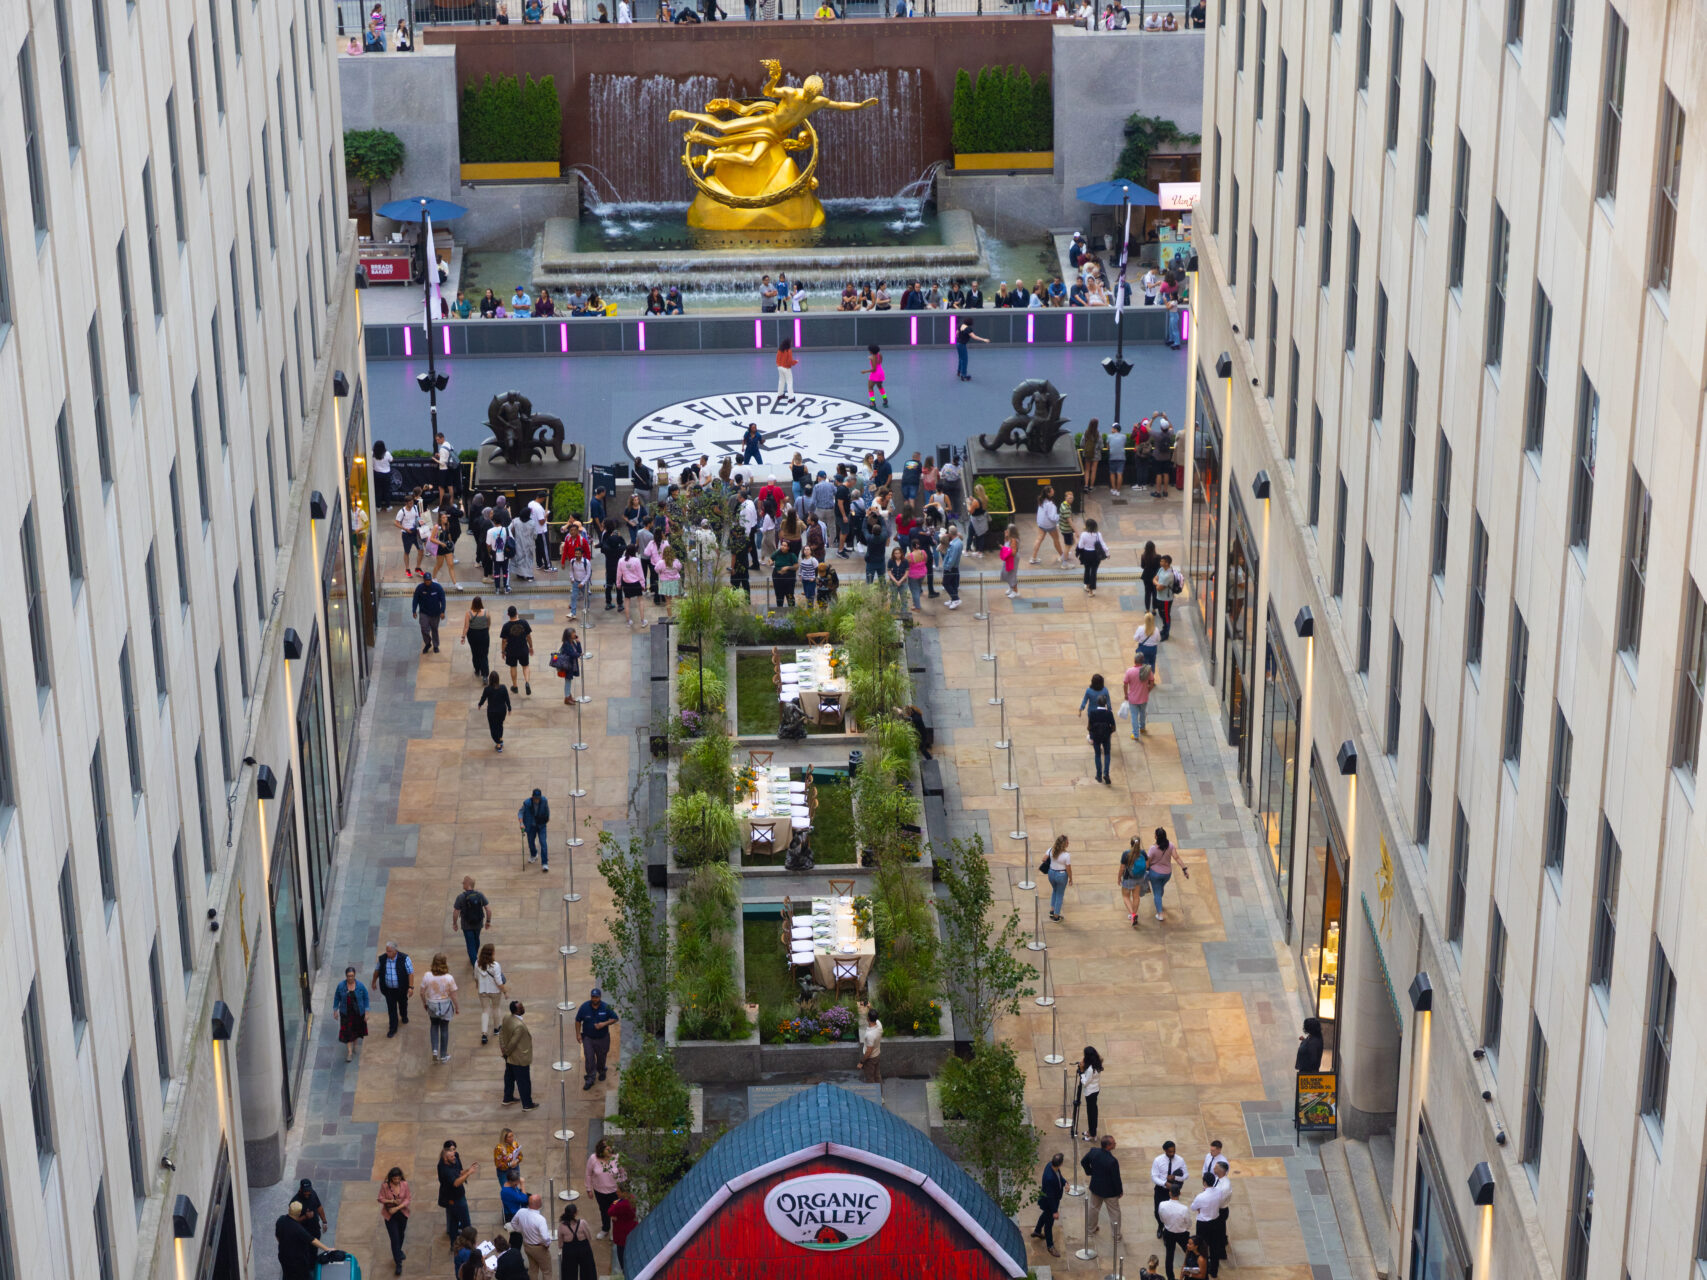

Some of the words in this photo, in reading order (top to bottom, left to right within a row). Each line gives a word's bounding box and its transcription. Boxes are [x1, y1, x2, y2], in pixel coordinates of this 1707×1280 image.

[683, 395, 842, 421] FLIPPER'S
[818, 412, 890, 464] ROLLER
[777, 1193, 879, 1213] ORGANIC
[786, 1209, 871, 1227] VALLEY
